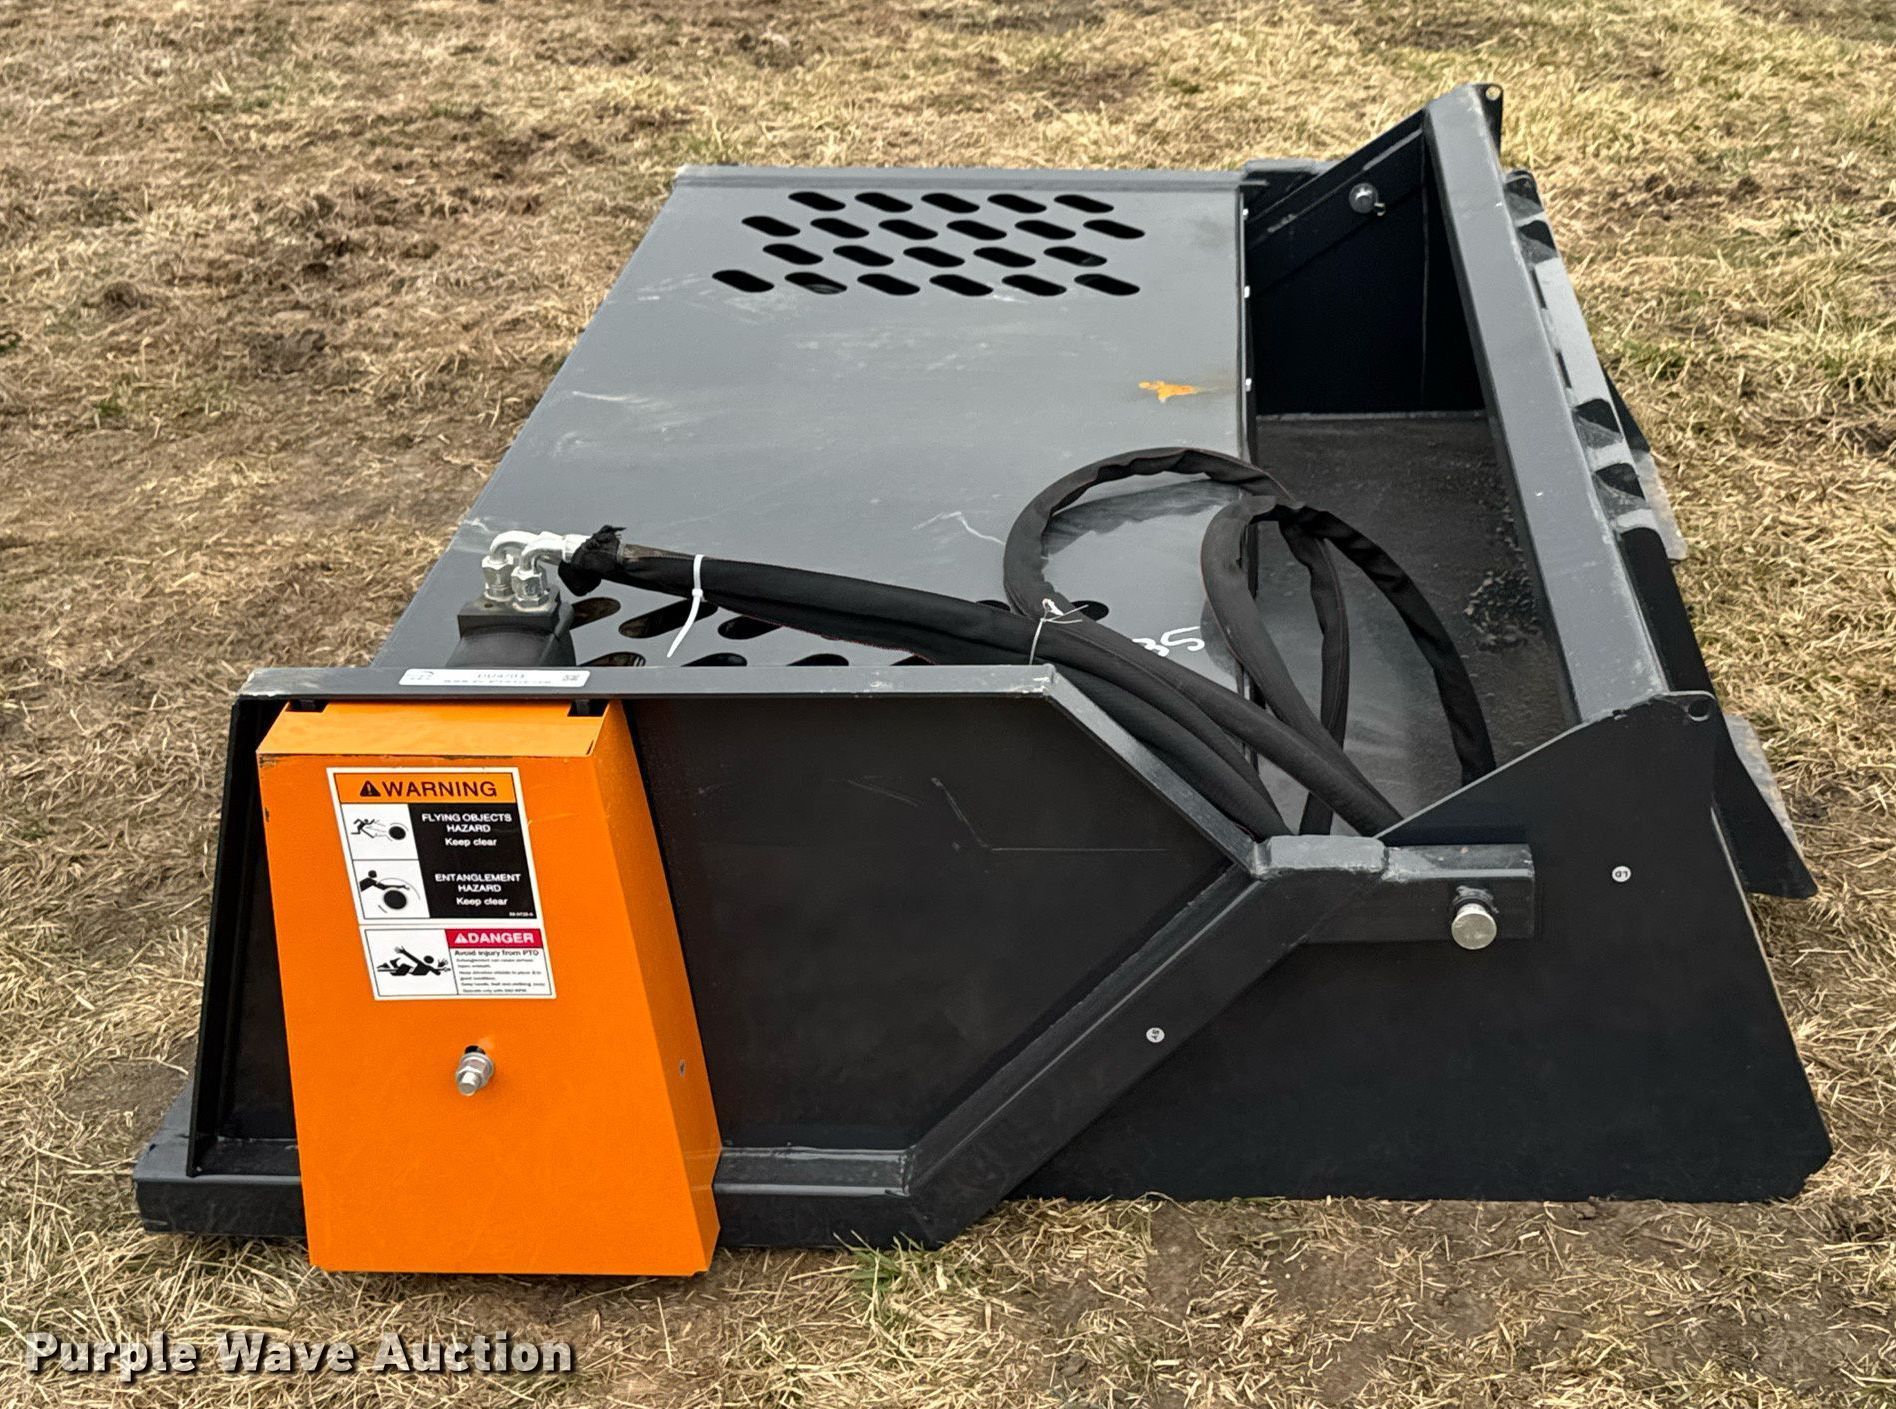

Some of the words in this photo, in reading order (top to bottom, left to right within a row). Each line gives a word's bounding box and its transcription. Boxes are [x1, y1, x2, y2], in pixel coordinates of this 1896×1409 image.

[382, 780, 498, 797] WARNING
[421, 813, 461, 822] FLYING
[462, 813, 513, 822] OBJECTS
[446, 824, 491, 833] HAZARD
[445, 838, 471, 847] Keep
[473, 837, 498, 846] clear
[434, 873, 521, 882] ENTANGLEMENT
[458, 884, 502, 893] HAZARD
[456, 897, 482, 906] Keep
[484, 897, 508, 906] clear
[467, 932, 535, 944] DANGER
